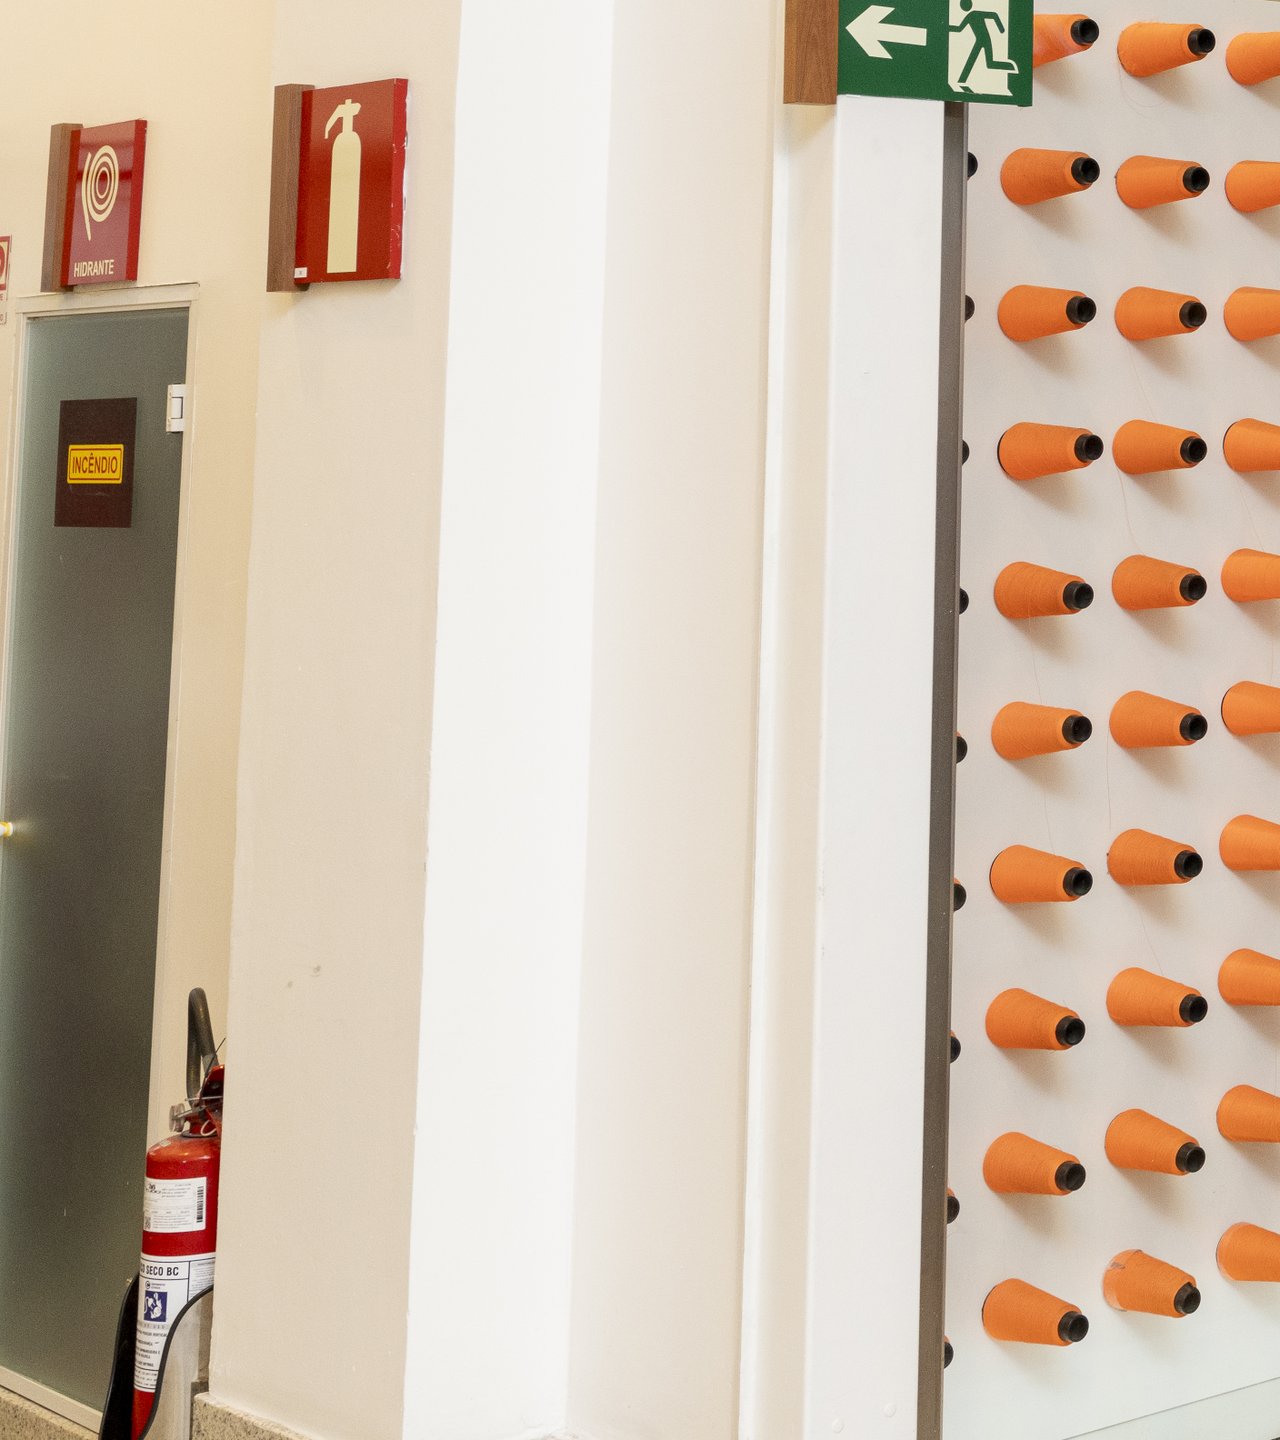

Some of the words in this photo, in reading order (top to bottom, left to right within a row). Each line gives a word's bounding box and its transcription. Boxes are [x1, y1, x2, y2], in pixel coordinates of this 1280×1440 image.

[73, 259, 114, 278] HIDRANTE
[71, 452, 119, 475] INCÊNDIO
[146, 1265, 164, 1276] SECO
[166, 1266, 179, 1276] BC
